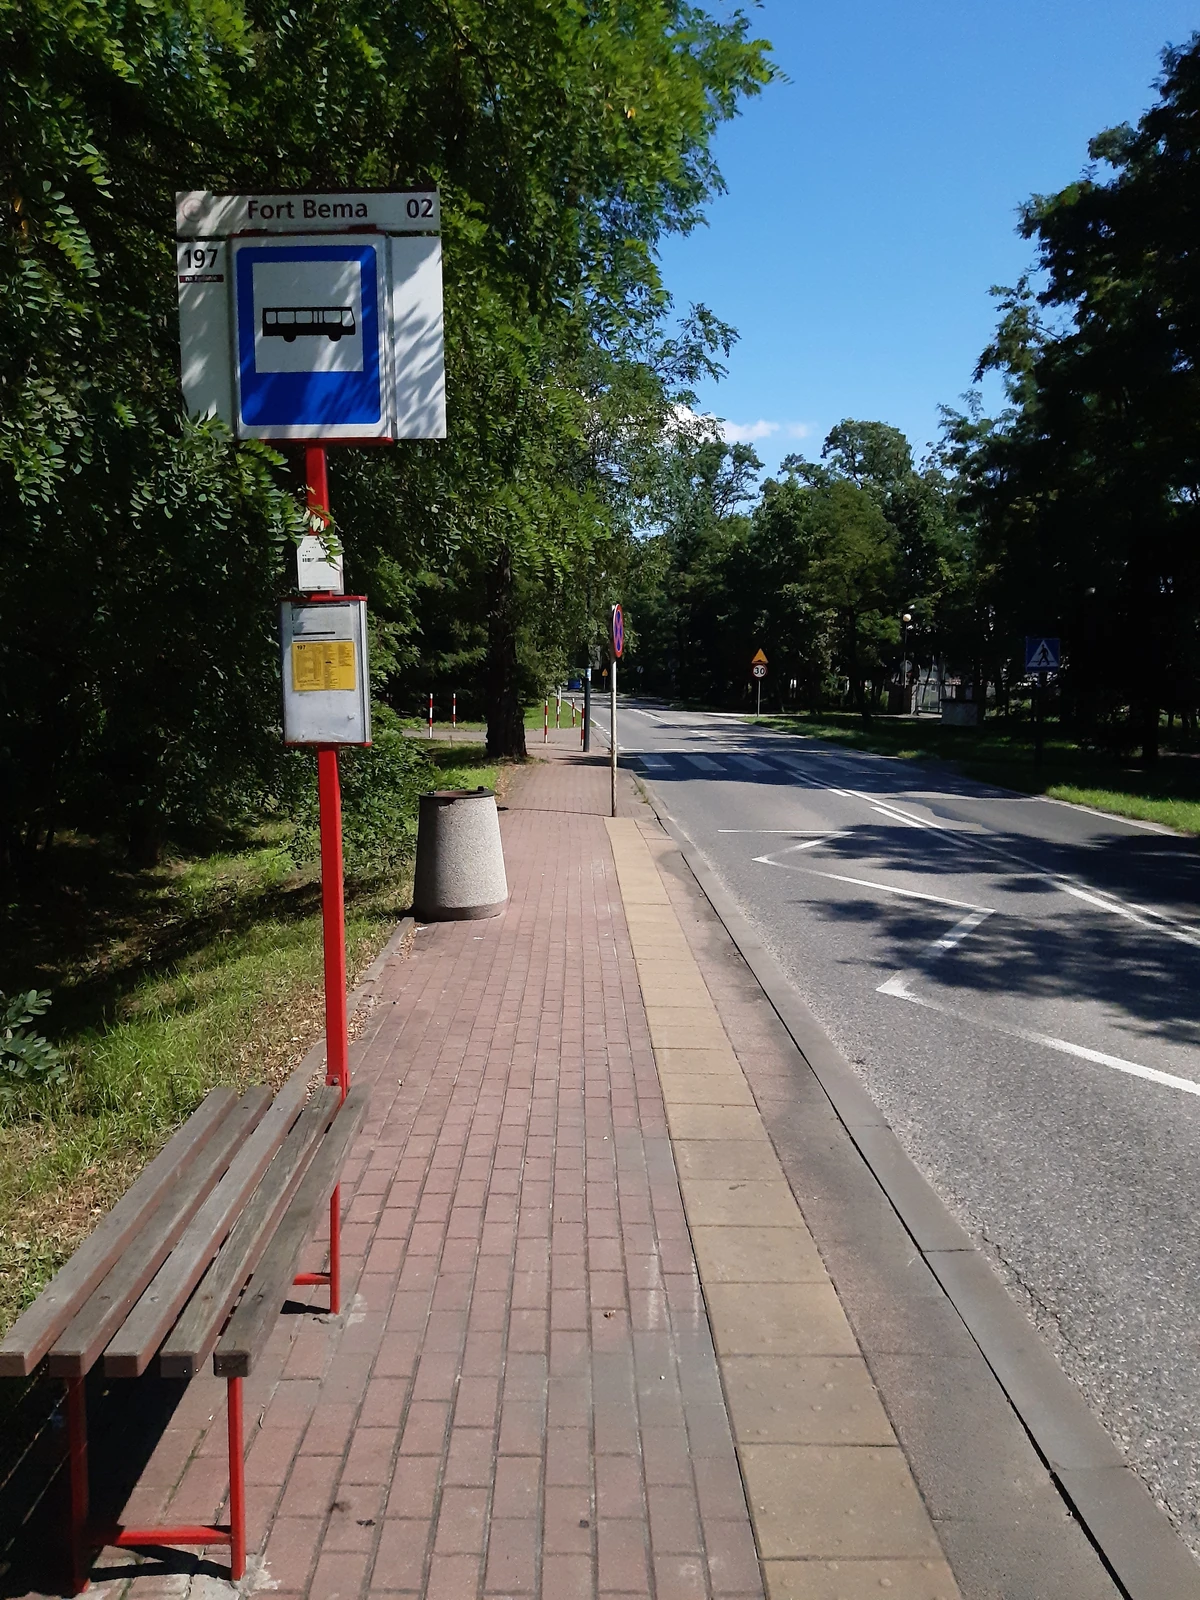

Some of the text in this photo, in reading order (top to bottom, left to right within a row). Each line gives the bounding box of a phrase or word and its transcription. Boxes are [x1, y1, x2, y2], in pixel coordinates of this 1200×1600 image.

[248, 199, 368, 219] Fort Bema
[406, 199, 433, 218] 02
[184, 249, 218, 268] 197
[755, 667, 765, 675] 30
